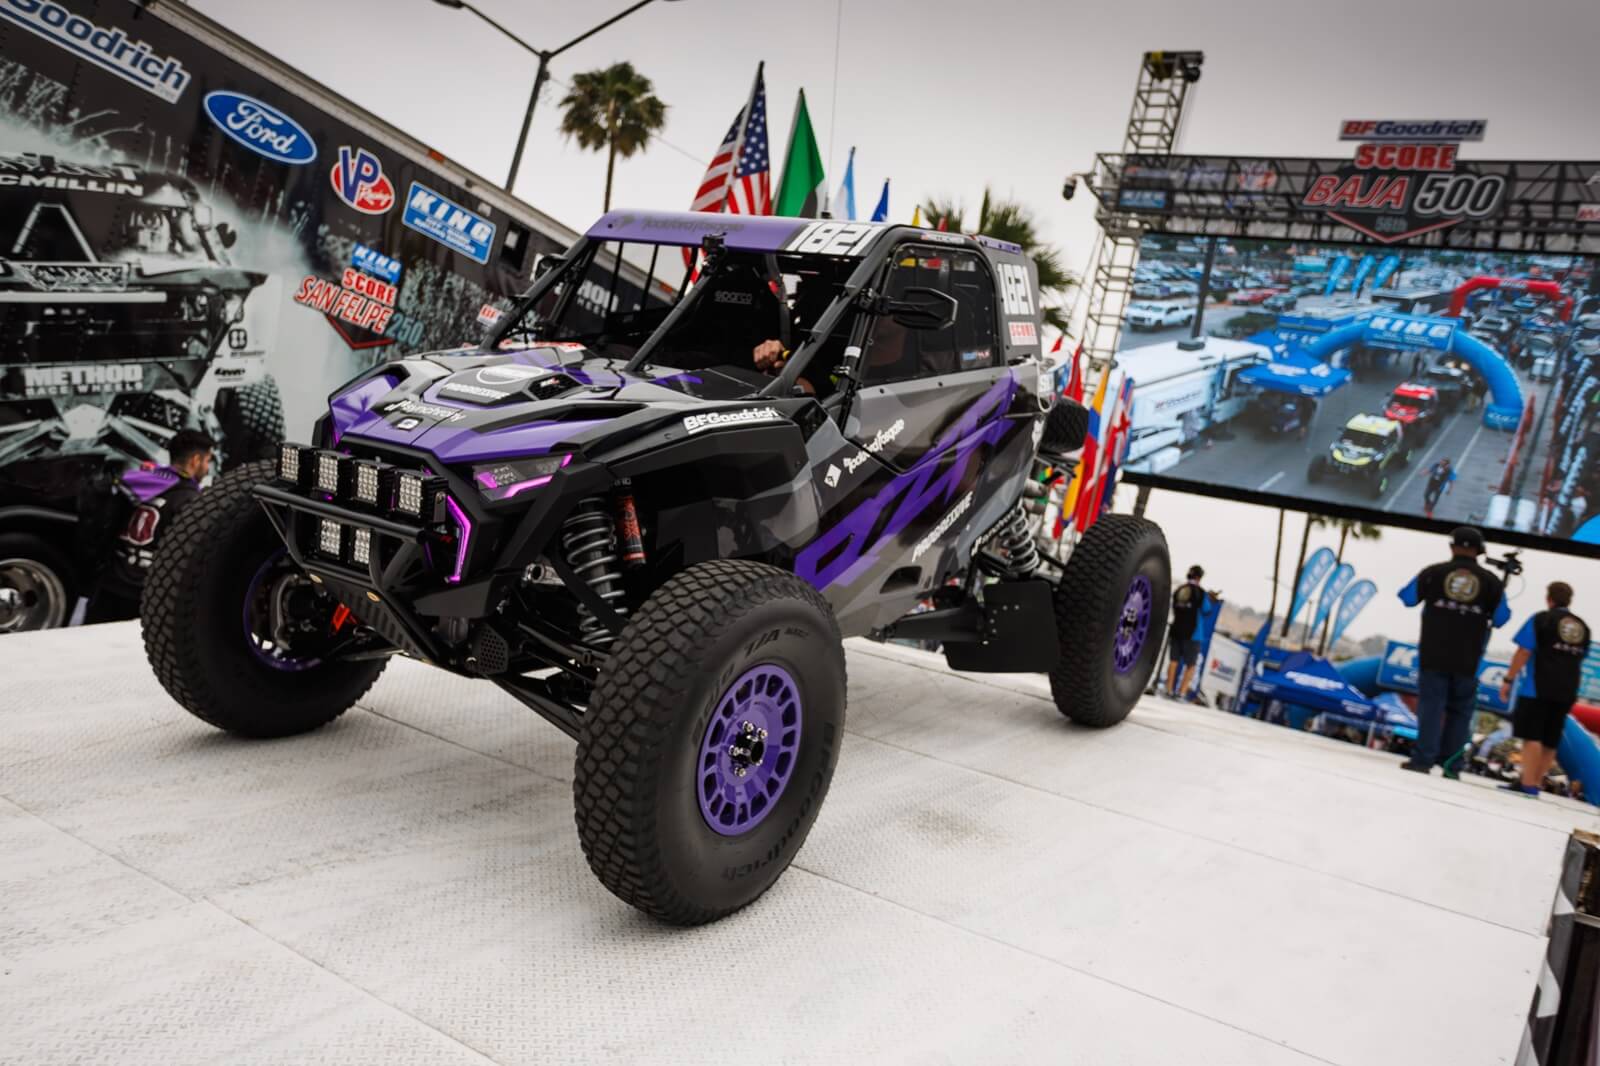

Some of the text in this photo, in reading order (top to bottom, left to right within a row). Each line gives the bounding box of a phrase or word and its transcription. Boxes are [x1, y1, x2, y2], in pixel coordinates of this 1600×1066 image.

[226, 101, 298, 154] Ford
[1342, 119, 1486, 136] BFGoodrich
[1355, 144, 1457, 172] SCORE
[337, 145, 382, 206] VP
[1303, 174, 1410, 210] BAJA
[1413, 173, 1505, 217] 500
[410, 189, 492, 243] KING
[785, 221, 887, 257] 1821
[353, 244, 401, 273] KING
[341, 266, 398, 308] SCORE
[293, 273, 425, 347] SAN FELIPE 250
[1368, 316, 1452, 339] KING
[24, 364, 143, 387] METHOD
[25, 381, 143, 397] RACE WHEELS
[683, 406, 780, 432] BFGoodrich
